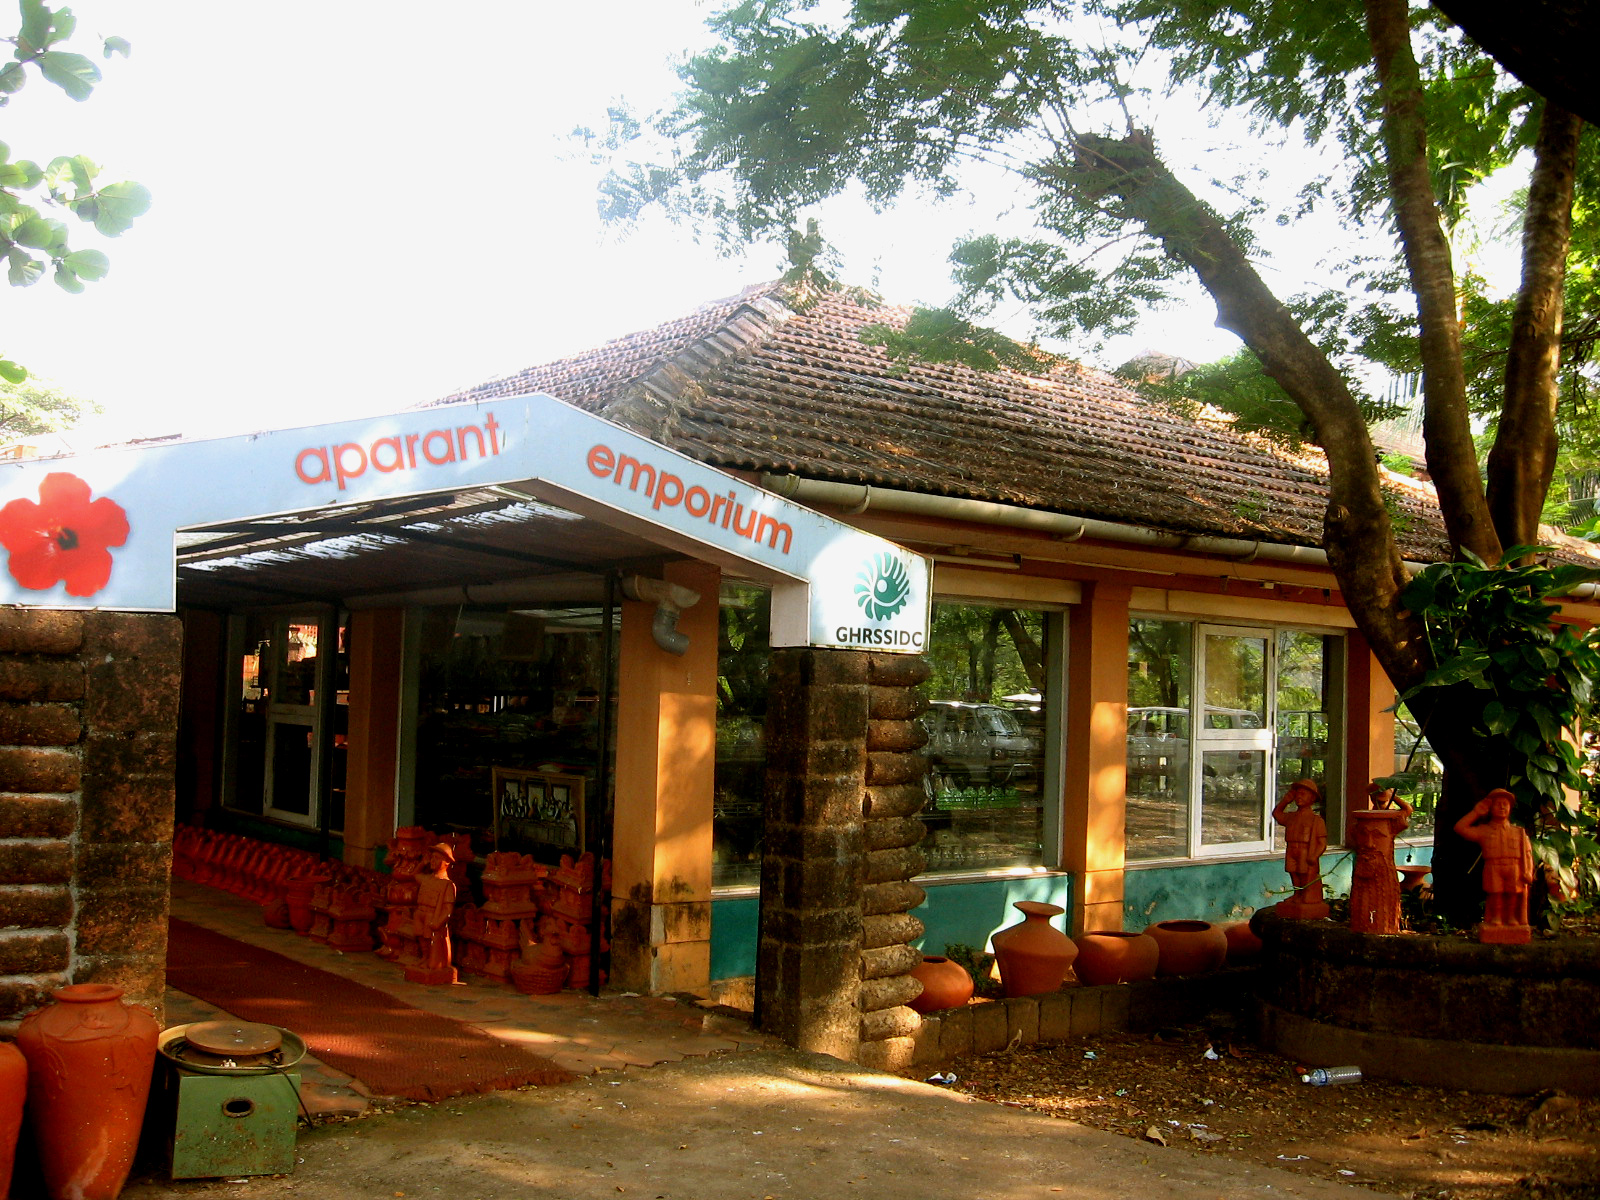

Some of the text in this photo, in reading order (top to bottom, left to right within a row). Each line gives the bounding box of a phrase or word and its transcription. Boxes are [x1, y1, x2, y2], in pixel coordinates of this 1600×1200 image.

[295, 412, 793, 555] aparant emporium
[835, 626, 923, 647] GHRSSIDC
